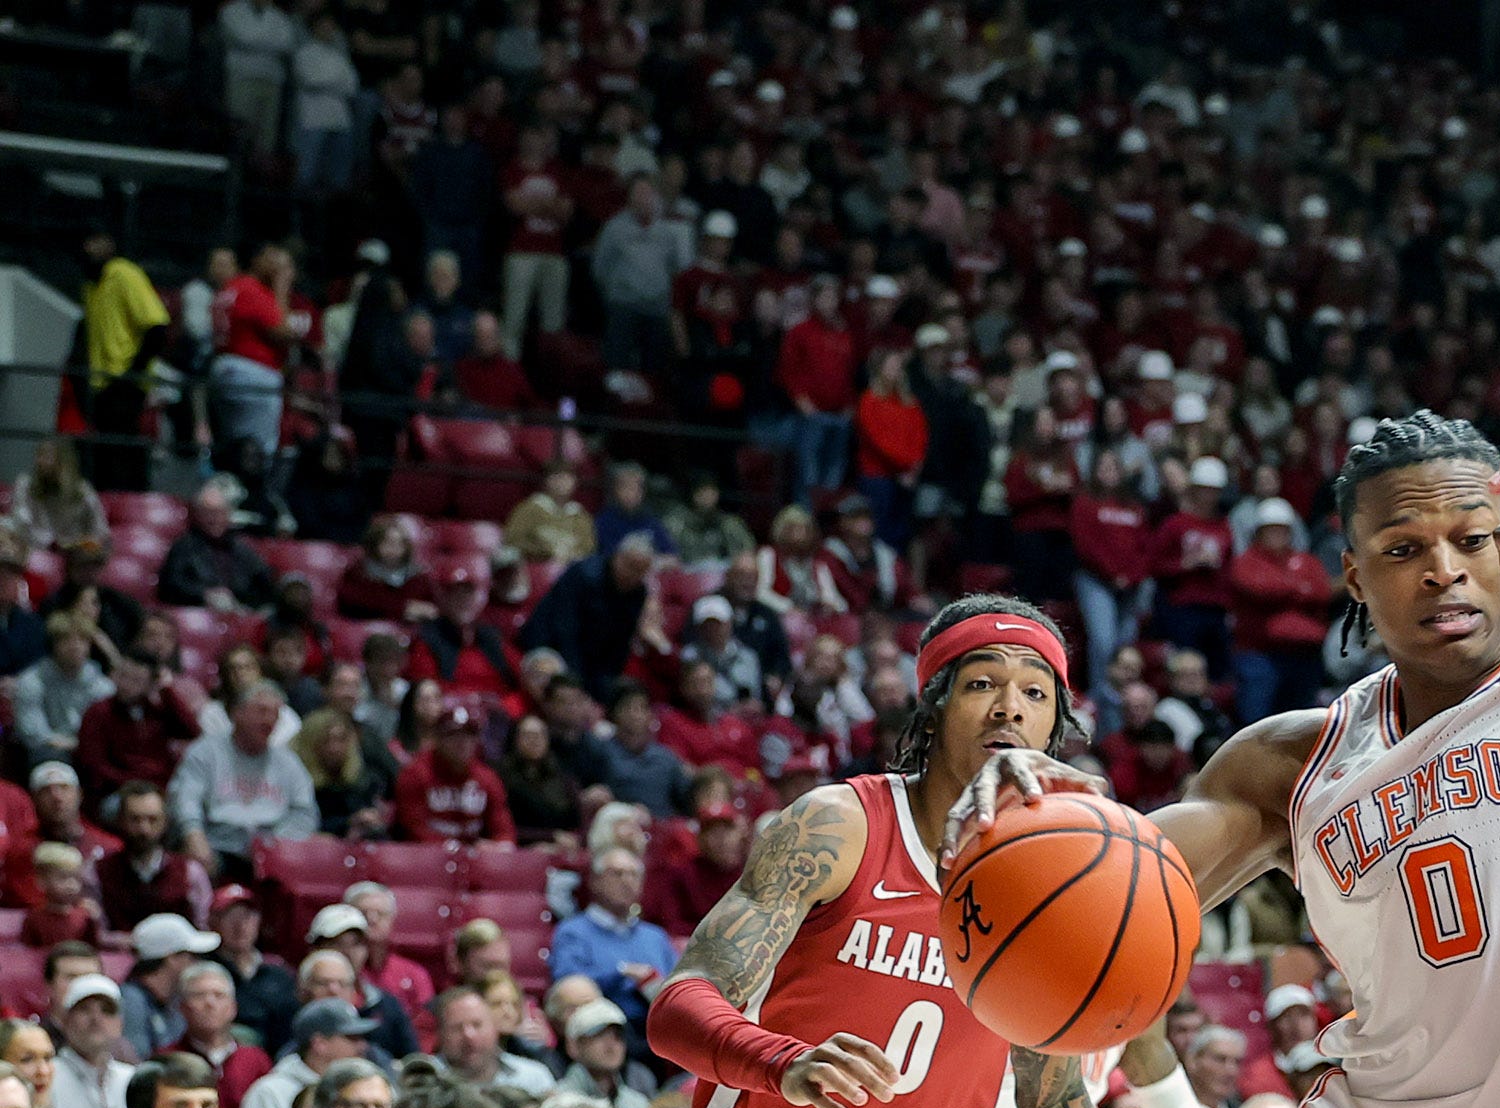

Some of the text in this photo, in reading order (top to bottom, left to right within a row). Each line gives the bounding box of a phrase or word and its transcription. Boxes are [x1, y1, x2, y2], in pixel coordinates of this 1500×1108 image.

[953, 879, 993, 963] A
[1397, 834, 1490, 969] 0
[836, 918, 954, 989] ALAB
[884, 999, 944, 1095] 0
